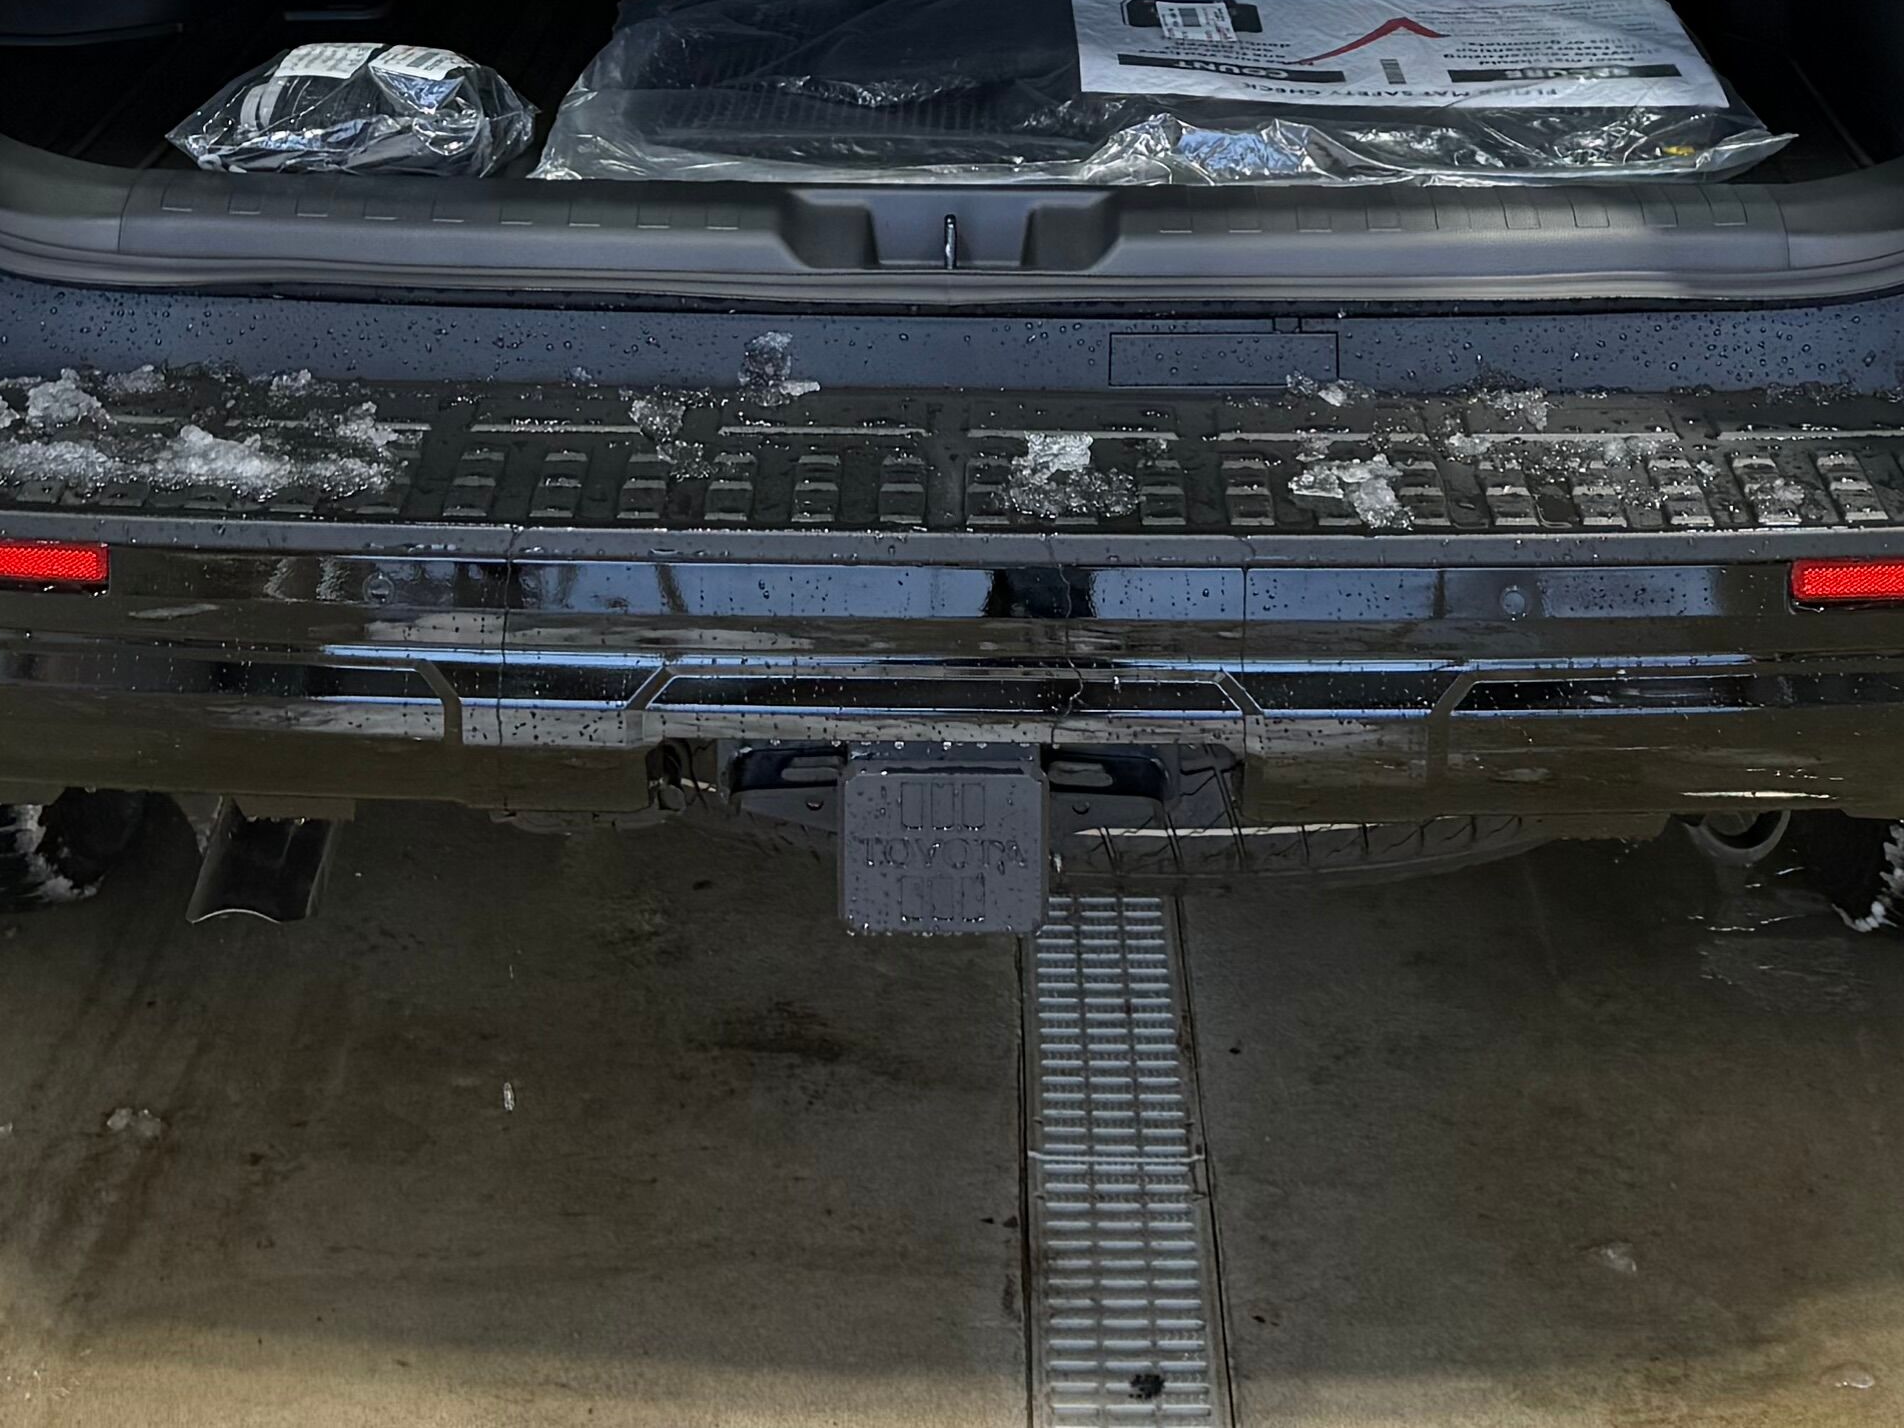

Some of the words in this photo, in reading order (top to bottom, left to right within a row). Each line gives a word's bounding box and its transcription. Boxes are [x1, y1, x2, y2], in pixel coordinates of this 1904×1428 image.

[1173, 61, 1289, 79] COUNT
[1241, 82, 1321, 96] CHECK
[856, 837, 1028, 869] TOYOTA
